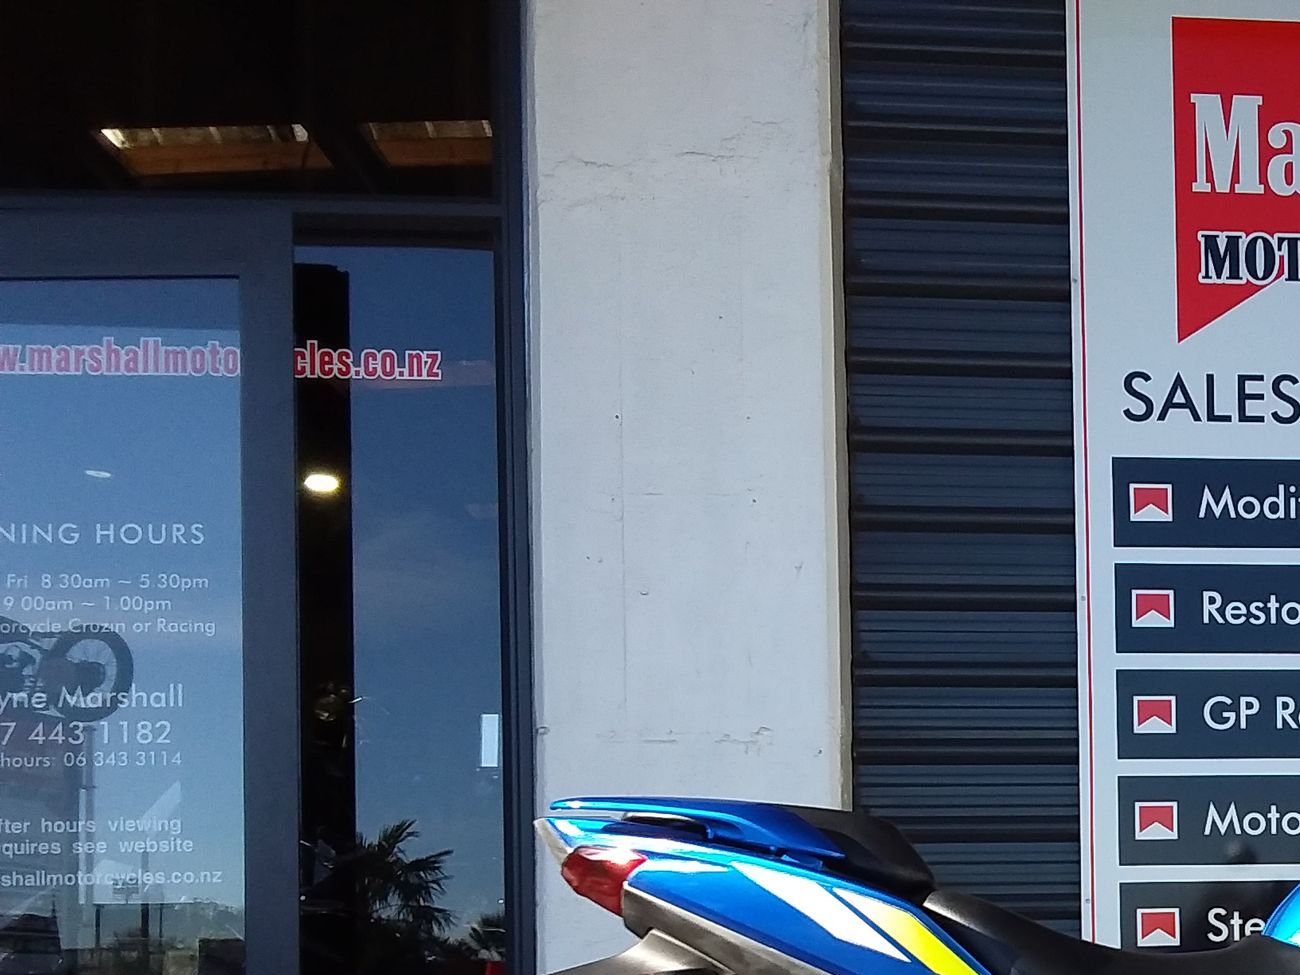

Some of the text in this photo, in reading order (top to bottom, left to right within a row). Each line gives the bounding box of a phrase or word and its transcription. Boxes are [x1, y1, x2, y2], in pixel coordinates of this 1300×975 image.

[1122, 371, 1300, 423] SALES
[95, 523, 205, 544] HOURS
[7, 573, 28, 588] Fri
[132, 621, 152, 633] or
[157, 618, 216, 637] Racing
[58, 683, 183, 707] Marshall
[1203, 696, 1260, 730] GP
[0, 721, 171, 745] 7 443 1182
[64, 752, 87, 767] 06
[94, 752, 128, 767] 343
[135, 751, 182, 766] 3114
[40, 818, 97, 833] hours
[108, 816, 182, 835] viewing
[72, 841, 107, 854] see
[119, 837, 194, 852] website
